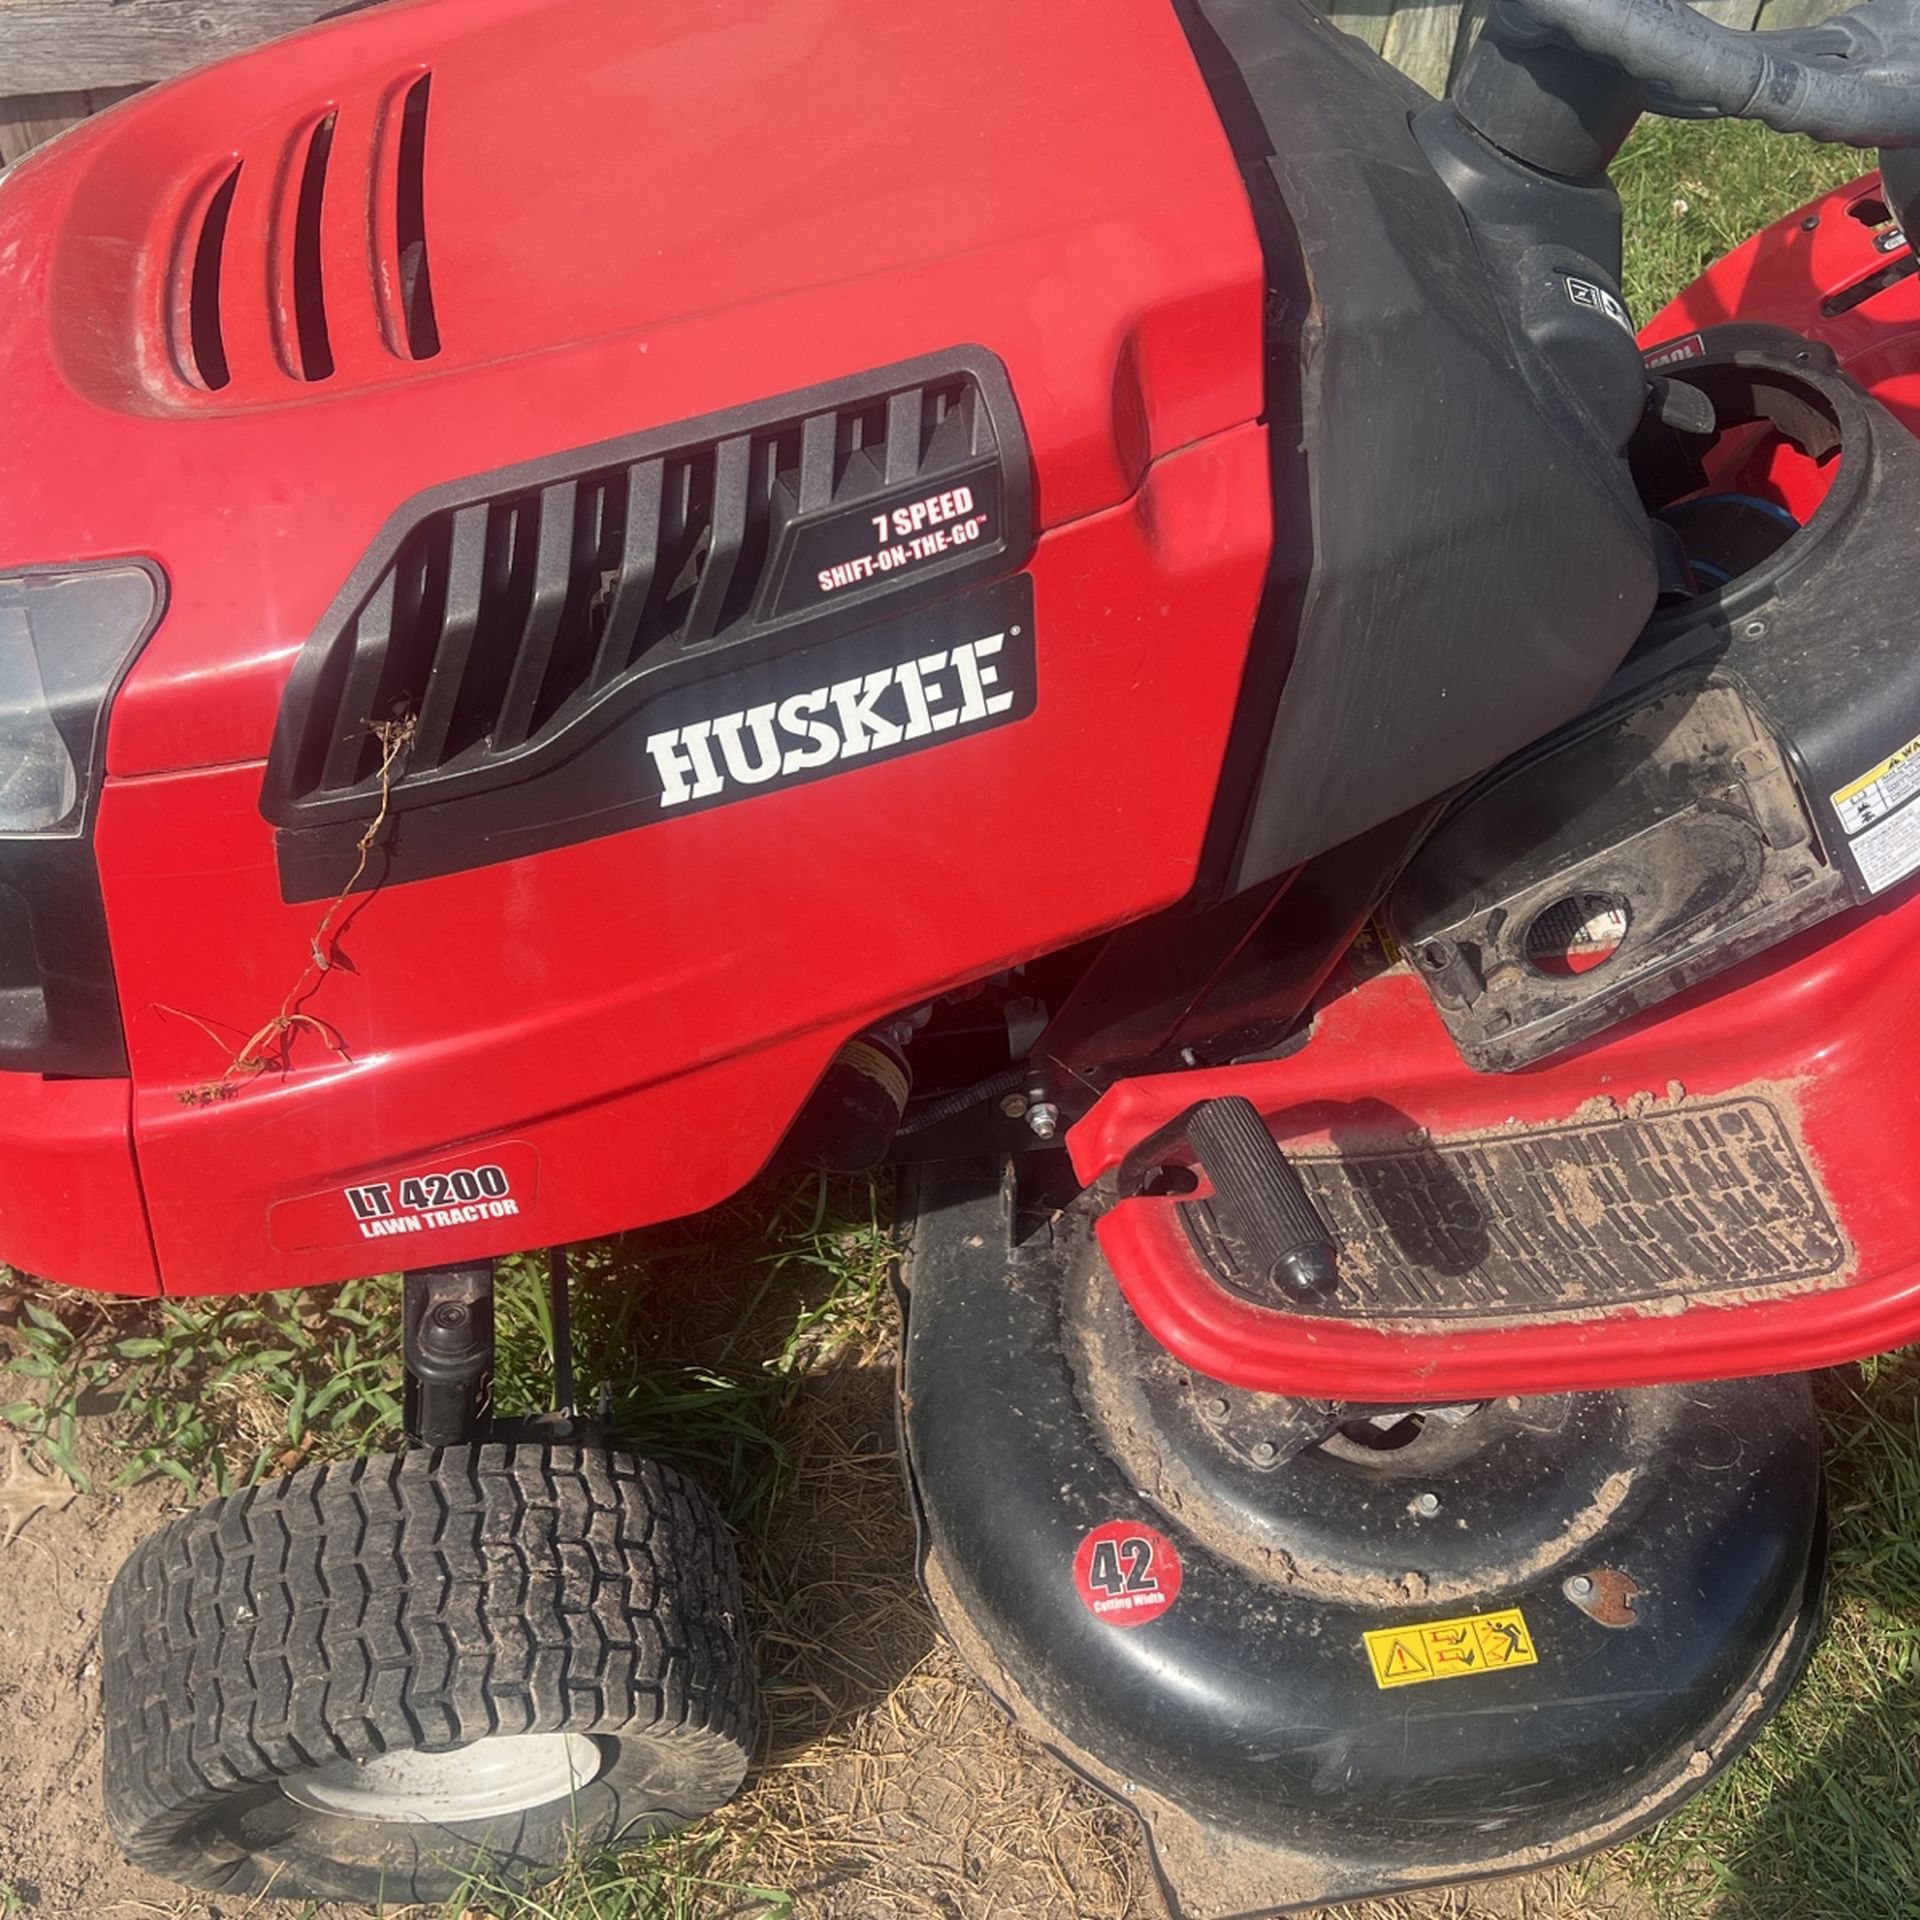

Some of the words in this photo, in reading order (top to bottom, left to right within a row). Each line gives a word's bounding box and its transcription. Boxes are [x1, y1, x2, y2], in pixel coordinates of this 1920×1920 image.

[872, 513, 889, 543] 7
[893, 486, 974, 537] SPEED
[344, 1183, 394, 1219] LT
[400, 1165, 509, 1209] 4200
[360, 1214, 422, 1239] LAWN
[422, 1198, 520, 1229] TRACTOR
[1093, 1595, 1132, 1613] Cutting
[1132, 1592, 1166, 1608] Width
